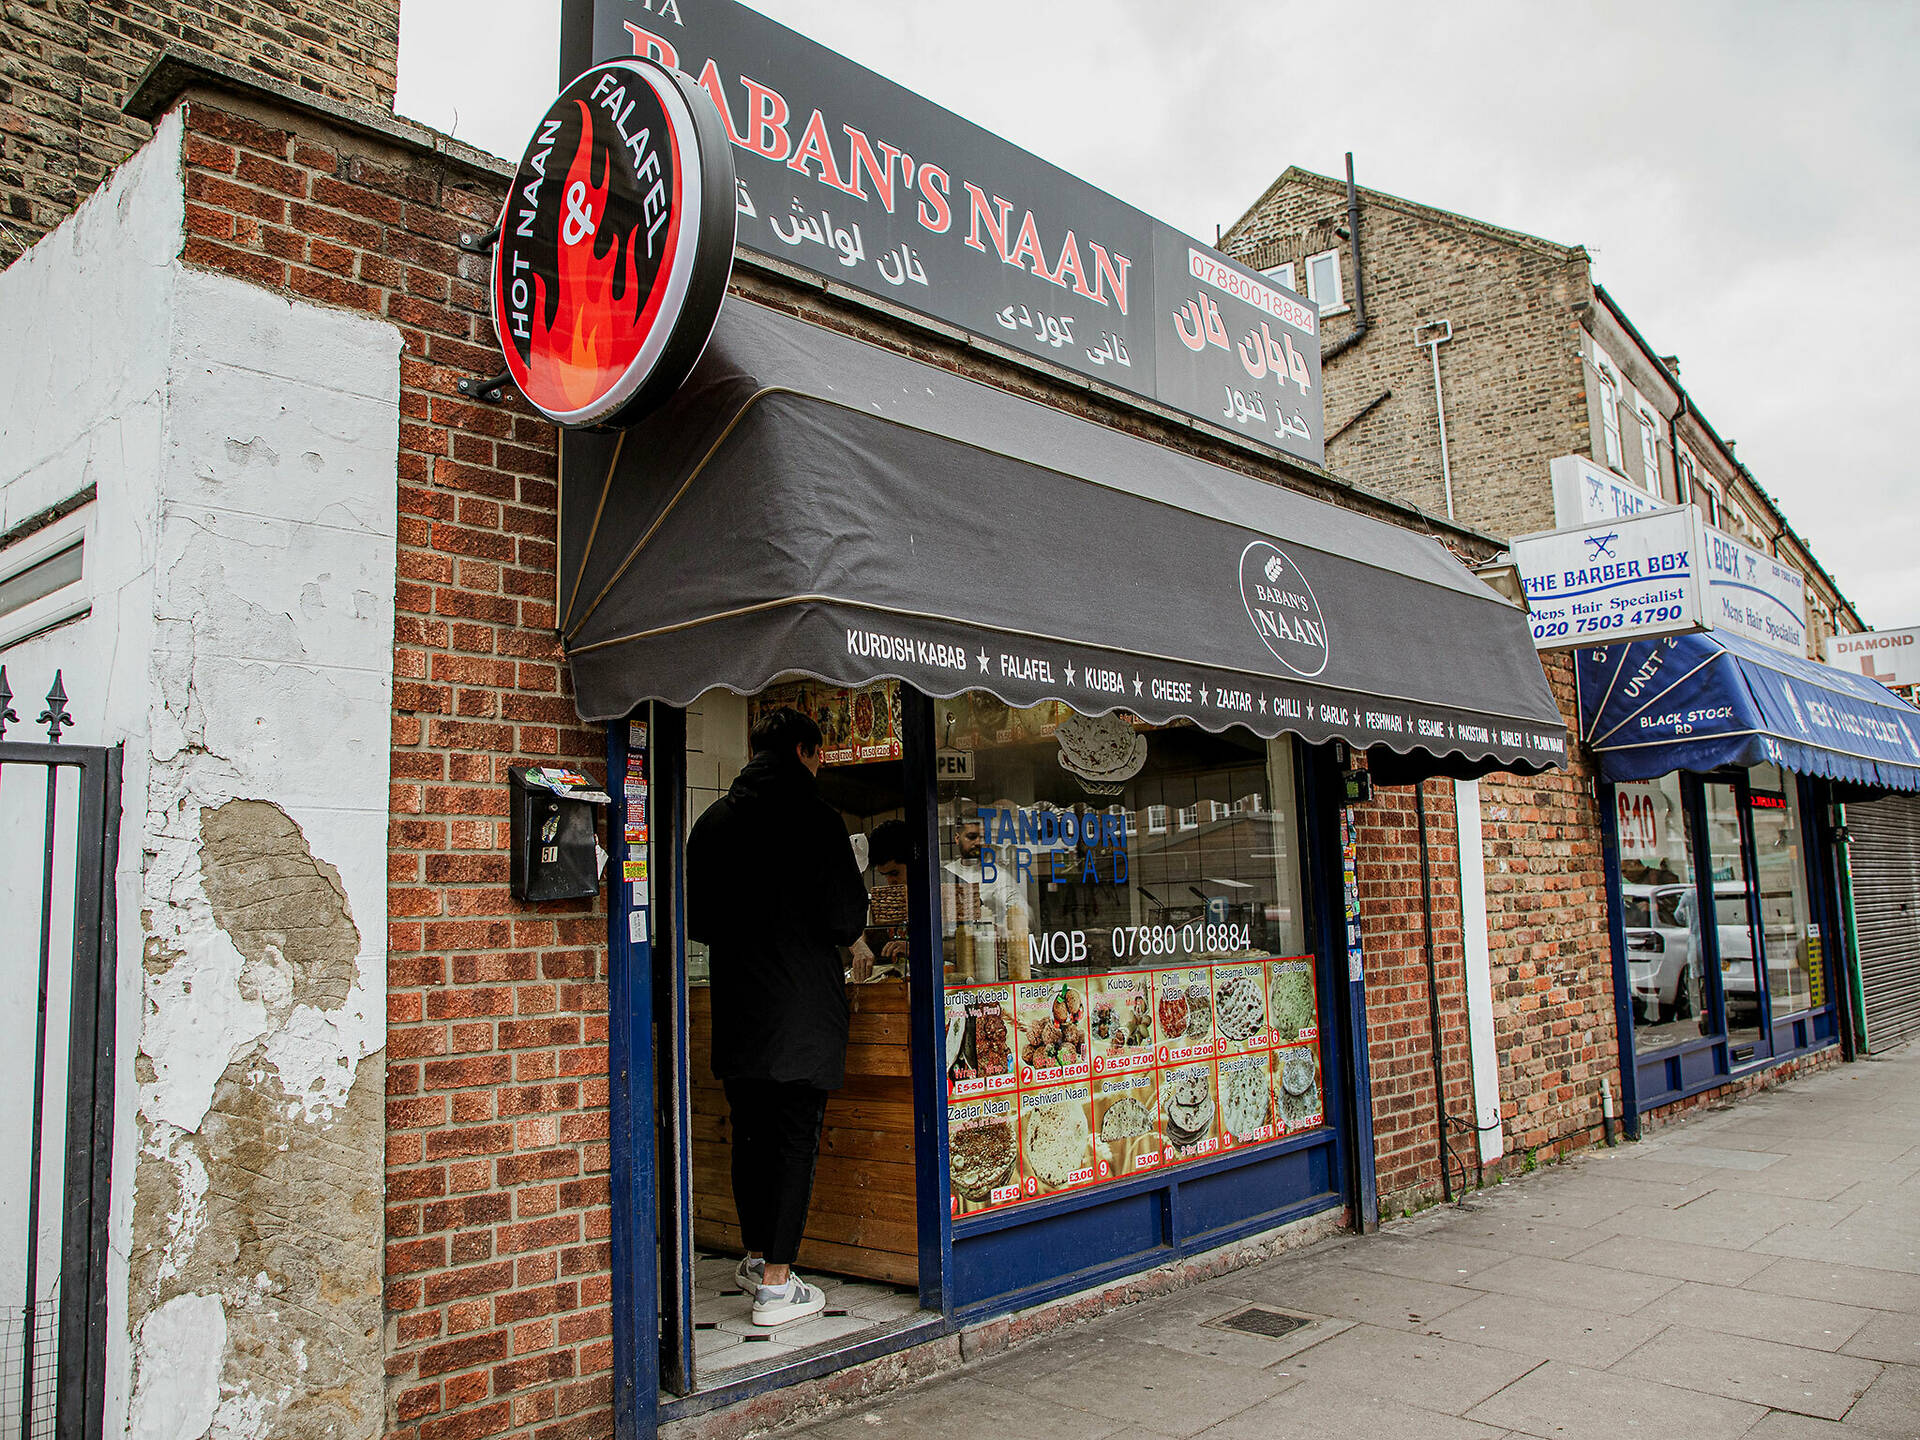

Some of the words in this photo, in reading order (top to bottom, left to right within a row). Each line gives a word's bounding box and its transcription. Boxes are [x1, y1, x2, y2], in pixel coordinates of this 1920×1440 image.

[515, 118, 563, 238] NAAN
[590, 73, 668, 259] FALAFEL
[562, 180, 596, 246] &
[964, 179, 1132, 315] NAAN
[510, 250, 532, 339] HOT
[1192, 256, 1313, 332] 07880018884
[1713, 537, 1740, 580] BOX
[1522, 574, 1557, 594] THE
[1564, 560, 1642, 588] BARBER
[1648, 551, 1690, 574] BOX
[1255, 584, 1309, 612] BABAN'S
[1529, 607, 1565, 622] Mens
[1572, 602, 1603, 616] Hair
[1610, 587, 1685, 611] Specialist
[1255, 608, 1326, 649] NAAN
[1533, 621, 1569, 639] 020
[1576, 613, 1624, 633] 7503
[1630, 604, 1683, 625] 4790
[1746, 607, 1763, 631] Hair
[1837, 635, 1914, 653] DIAMOND
[1623, 650, 1664, 698] UNIT
[847, 629, 916, 664] KURDISH
[918, 642, 967, 671] KABAB
[1000, 654, 1055, 684] FALAFEL
[1085, 666, 1125, 694] KUBBA
[1151, 678, 1192, 704] CHEESE
[1216, 687, 1252, 712] ZAATAR
[1273, 697, 1301, 719] CHILLI
[1320, 703, 1348, 726] GARLIC
[1366, 711, 1403, 732] PESHWARI
[1417, 718, 1445, 739] SESAME
[1500, 730, 1523, 748] BARLEY
[1640, 713, 1682, 728] BLACK
[1687, 706, 1734, 722] STOCK
[1675, 723, 1693, 735] RD
[938, 755, 966, 774] PEN
[977, 808, 1128, 848] TANDOORI
[1618, 791, 1657, 849] £10
[541, 846, 558, 862] 51
[980, 847, 1128, 885] BREAD
[1028, 930, 1088, 965] MOB
[1112, 925, 1176, 957] 07880
[1182, 923, 1252, 952] 018884
[1108, 978, 1133, 990] Kubba
[1215, 967, 1243, 979] Sesame
[1244, 966, 1262, 976] Naan
[945, 991, 976, 1006] urdish
[978, 988, 1009, 1003] Kebab
[1020, 984, 1049, 999] Falafel
[1218, 1038, 1226, 1053] 5
[1249, 1036, 1268, 1046] £1.50
[1272, 1029, 1279, 1044] 6
[1095, 1056, 1103, 1072] 3
[1107, 1057, 1131, 1069] £6.50
[1132, 1054, 1154, 1065] £7.00
[1159, 1047, 1168, 1062] 4
[1023, 1067, 1031, 1083] 2
[1036, 1068, 1063, 1081] £5.50
[1191, 1066, 1210, 1078] Naan
[1022, 1090, 1063, 1108] Peshwari
[1065, 1086, 1088, 1100] Naan
[1102, 1080, 1130, 1093] Cheese
[1131, 1077, 1151, 1088] Naan
[948, 1105, 981, 1120] Zaatar
[984, 1101, 1010, 1115] Naan
[1100, 1162, 1108, 1177] 9
[1137, 1153, 1160, 1166] £3.00
[1164, 1147, 1174, 1160] 10
[1027, 1178, 1036, 1194] 8
[1069, 1169, 1094, 1182] £3.00
[992, 1187, 1020, 1201] £1.50
